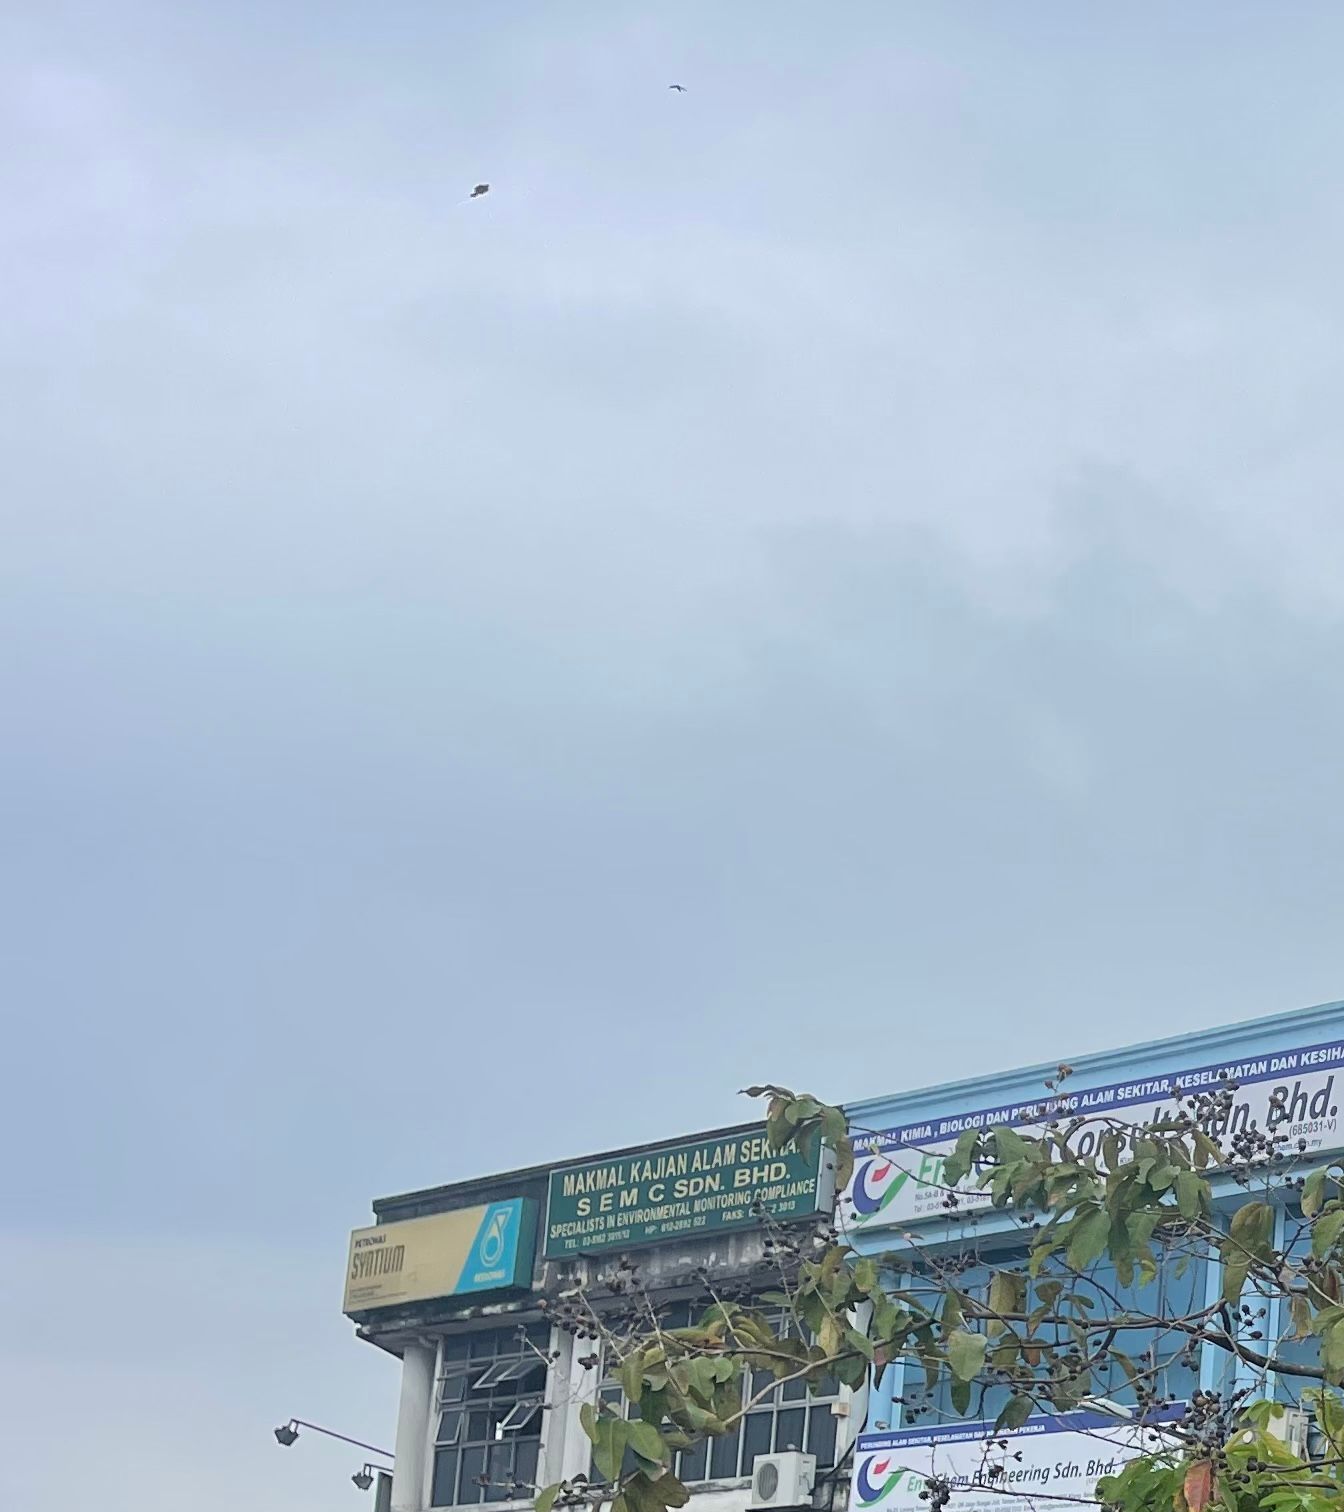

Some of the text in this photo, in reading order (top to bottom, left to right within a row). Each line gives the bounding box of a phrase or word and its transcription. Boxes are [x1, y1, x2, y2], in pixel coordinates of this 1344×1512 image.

[853, 1135, 897, 1151] MAKMAL
[900, 1124, 932, 1142] KIMIA
[939, 1115, 985, 1135] BIOLOGI
[986, 1110, 1010, 1127] DAN
[1081, 1088, 1115, 1110] ALAM
[1117, 1079, 1172, 1101] SEKITAR,
[1270, 1053, 1298, 1072] DAN
[1266, 1075, 1338, 1127] Bhd.
[563, 1168, 626, 1197] MAKMAL
[630, 1157, 687, 1182] KAJIAN
[692, 1144, 735, 1173] ALAM
[673, 1173, 725, 1198] SDN.
[733, 1162, 791, 1188] BHD.
[550, 1216, 605, 1240] SPECIALISTS
[606, 1214, 616, 1229] IN
[616, 1199, 691, 1226] ENVIRONMENTAL
[693, 1190, 751, 1214] MONITORING
[753, 1178, 816, 1203] COMPLIANCE
[1053, 1463, 1082, 1479] Sdn.
[1086, 1458, 1116, 1476] Bhd.
